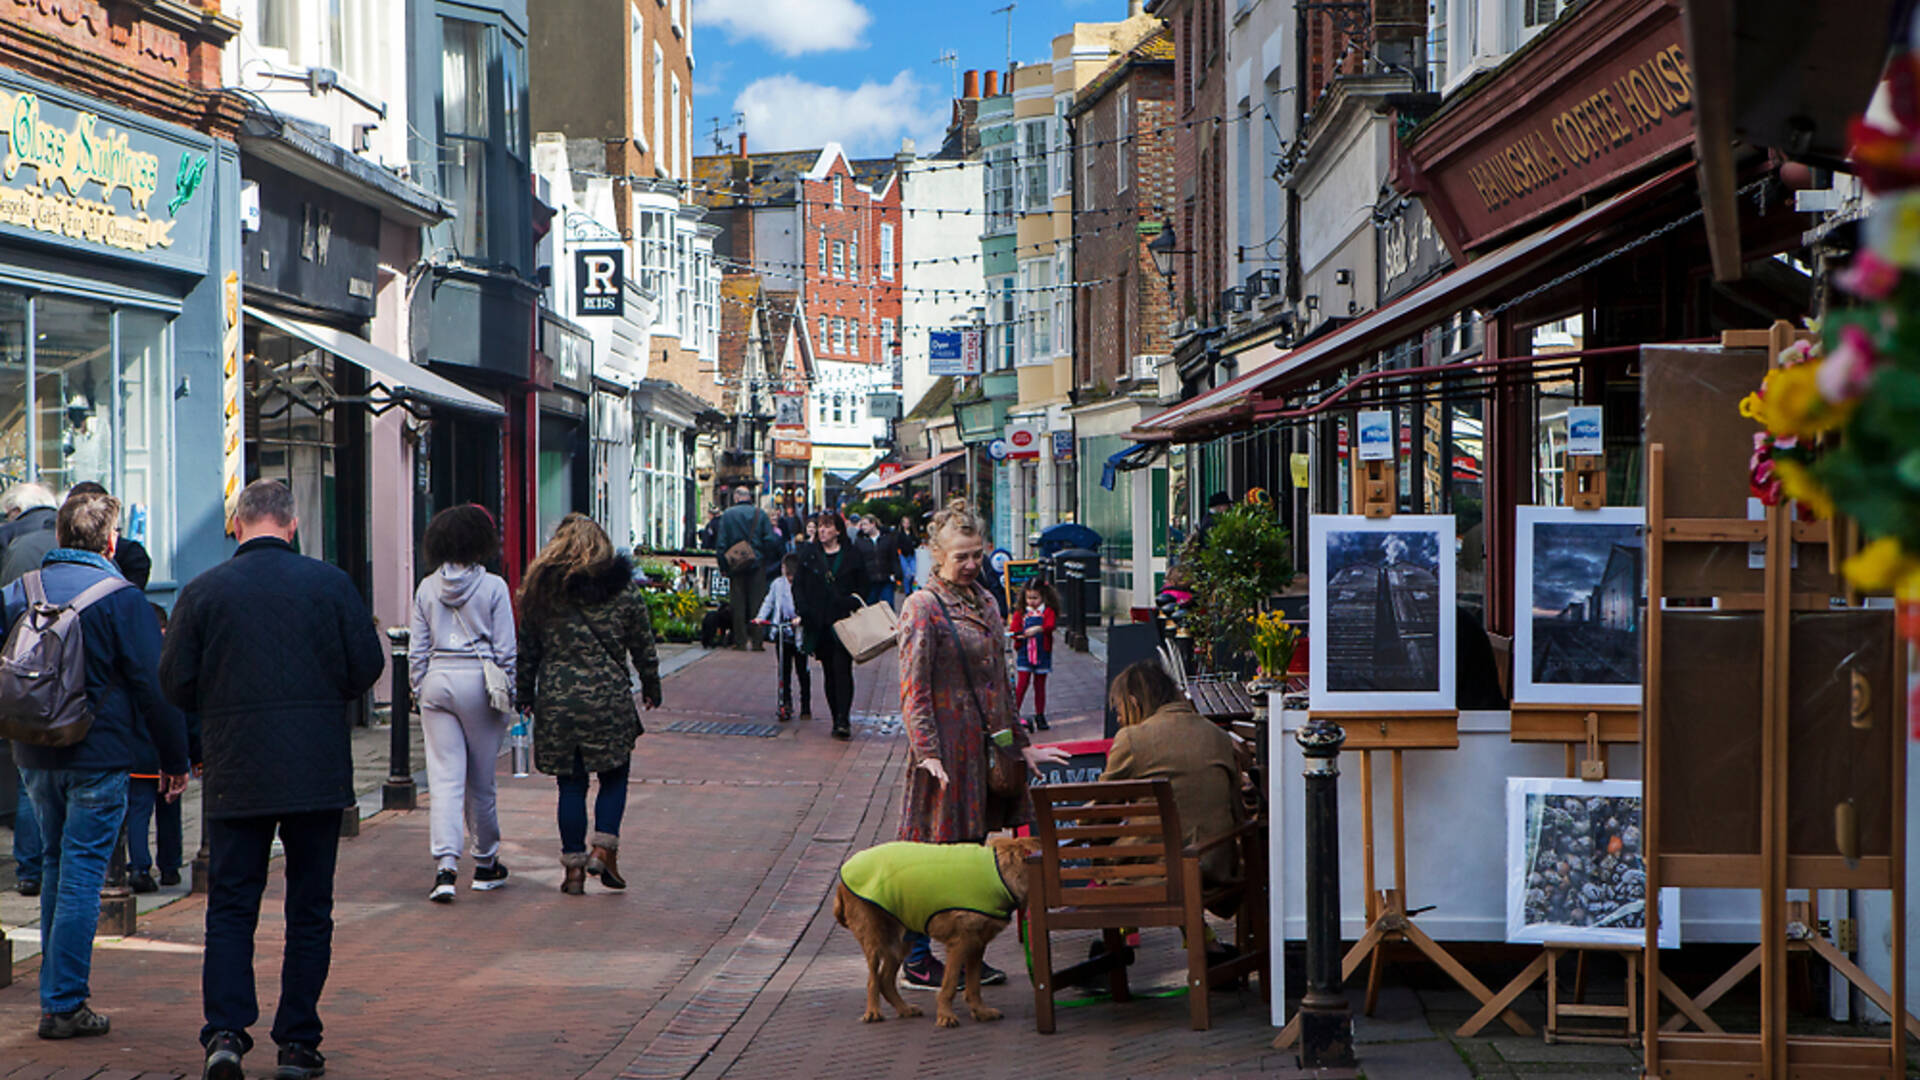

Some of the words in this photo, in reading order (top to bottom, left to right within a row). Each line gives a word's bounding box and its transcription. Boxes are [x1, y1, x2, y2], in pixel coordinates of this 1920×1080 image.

[12, 94, 66, 168] Glass
[1468, 130, 1565, 207] HANUSHKA
[1551, 88, 1631, 163] COFFEE
[0, 196, 31, 220] espoke
[584, 255, 619, 294] R
